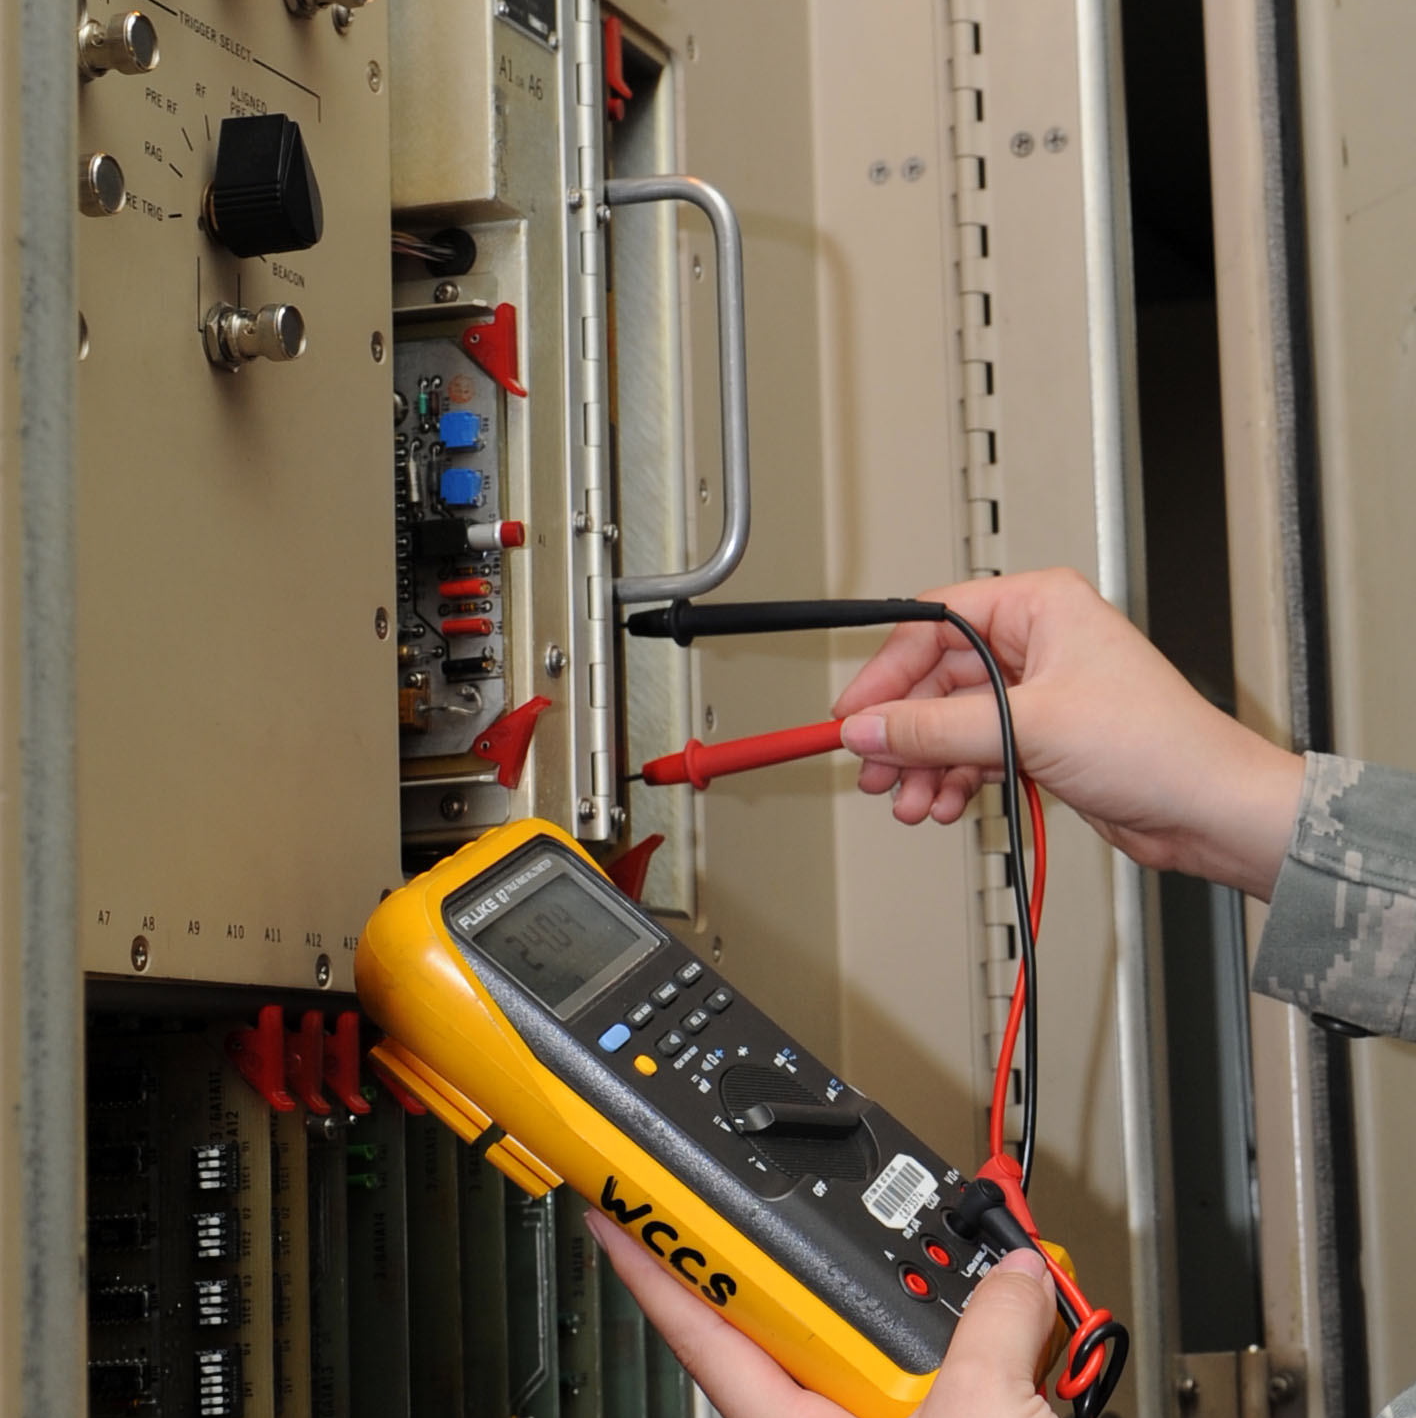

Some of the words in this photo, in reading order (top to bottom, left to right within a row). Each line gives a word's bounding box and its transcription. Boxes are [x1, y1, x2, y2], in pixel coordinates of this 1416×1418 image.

[178, 9, 218, 44] TRIGGER
[218, 33, 252, 63] SELECT
[194, 82, 208, 100] RF
[498, 54, 514, 83] A1
[527, 72, 544, 102] A6
[144, 86, 164, 109] PRE
[165, 101, 179, 116] RF
[230, 85, 268, 116] ALIGNED
[143, 140, 163, 163] RAG
[124, 191, 140, 212] RE
[141, 199, 164, 223] TRIG
[272, 262, 306, 289] BEACON
[457, 896, 500, 931] FLUKE
[97, 909, 111, 926] A7
[142, 916, 156, 932] A8
[187, 920, 200, 936] A9
[226, 924, 245, 940] A10
[264, 927, 282, 943] A11
[305, 932, 322, 948] A12
[343, 935, 359, 951] A13
[226, 1110, 239, 1137] A12
[601, 1175, 737, 1307] WCCS
[883, 1249, 896, 1262] A
